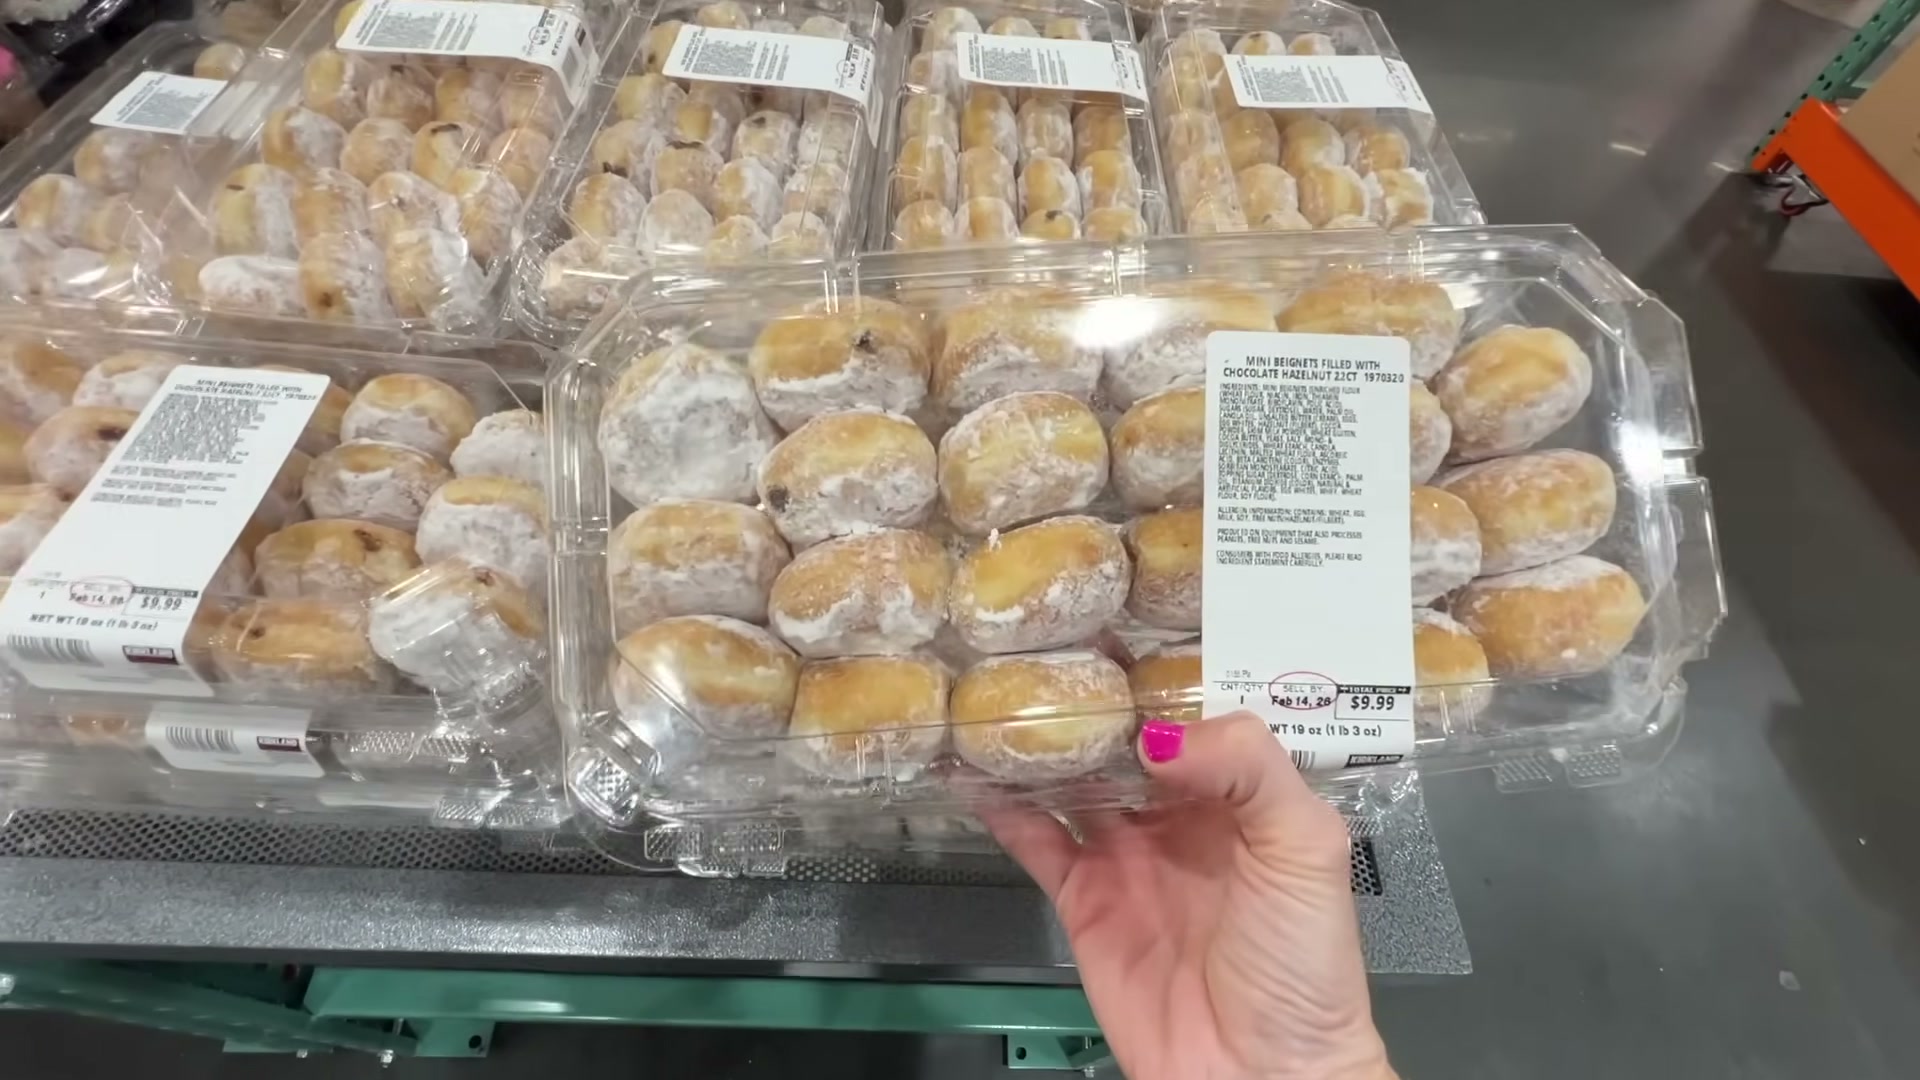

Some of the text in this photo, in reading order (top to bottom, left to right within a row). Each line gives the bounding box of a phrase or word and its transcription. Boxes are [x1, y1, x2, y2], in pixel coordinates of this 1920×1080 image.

[1246, 356, 1380, 370] MINI BEIGNETS FILLED WITH
[1223, 368, 1404, 383] CHOCOLATE HAZELNUT 22CT 1970320
[140, 596, 182, 611] $9.99
[29, 613, 54, 622] NET
[56, 615, 74, 624] WT
[1221, 682, 1263, 692] CNT/QTY
[1283, 685, 1304, 693] SELL
[1296, 696, 1312, 707] 14,
[1350, 696, 1394, 710] $9.99
[1270, 724, 1382, 738] WT 19 oz (1 lb 3 oz)
